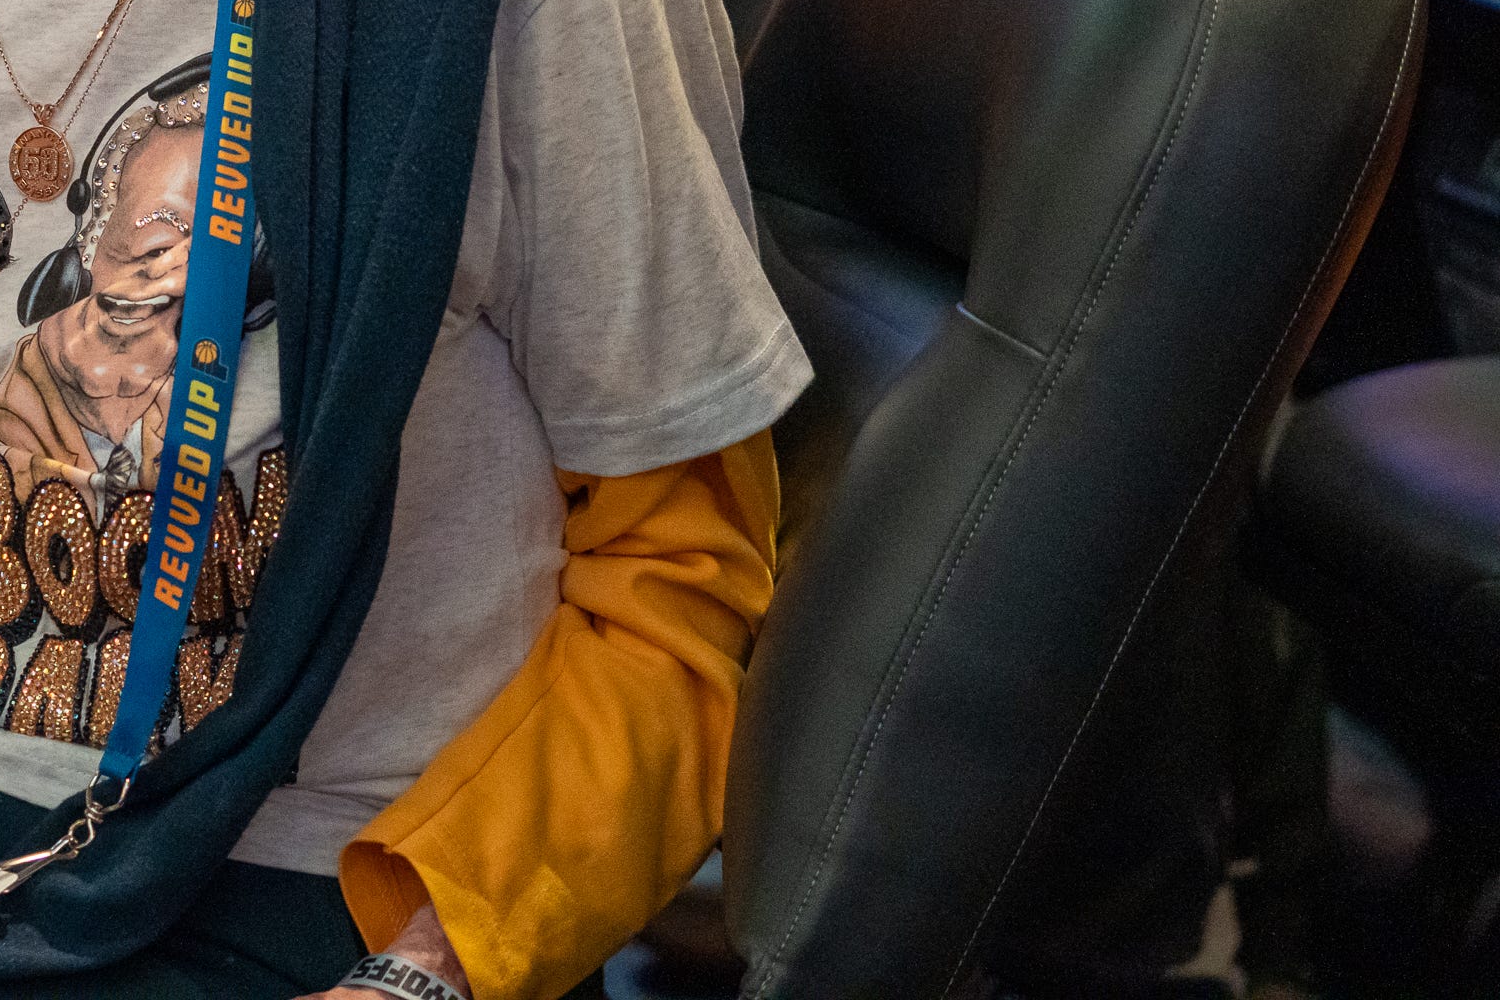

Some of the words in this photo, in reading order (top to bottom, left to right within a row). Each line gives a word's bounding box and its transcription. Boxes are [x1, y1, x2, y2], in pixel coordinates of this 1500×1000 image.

[209, 91, 253, 246] REVVED
[154, 443, 211, 611] REVVED
[183, 379, 220, 441] UP
[351, 957, 460, 1000] YOFFS
